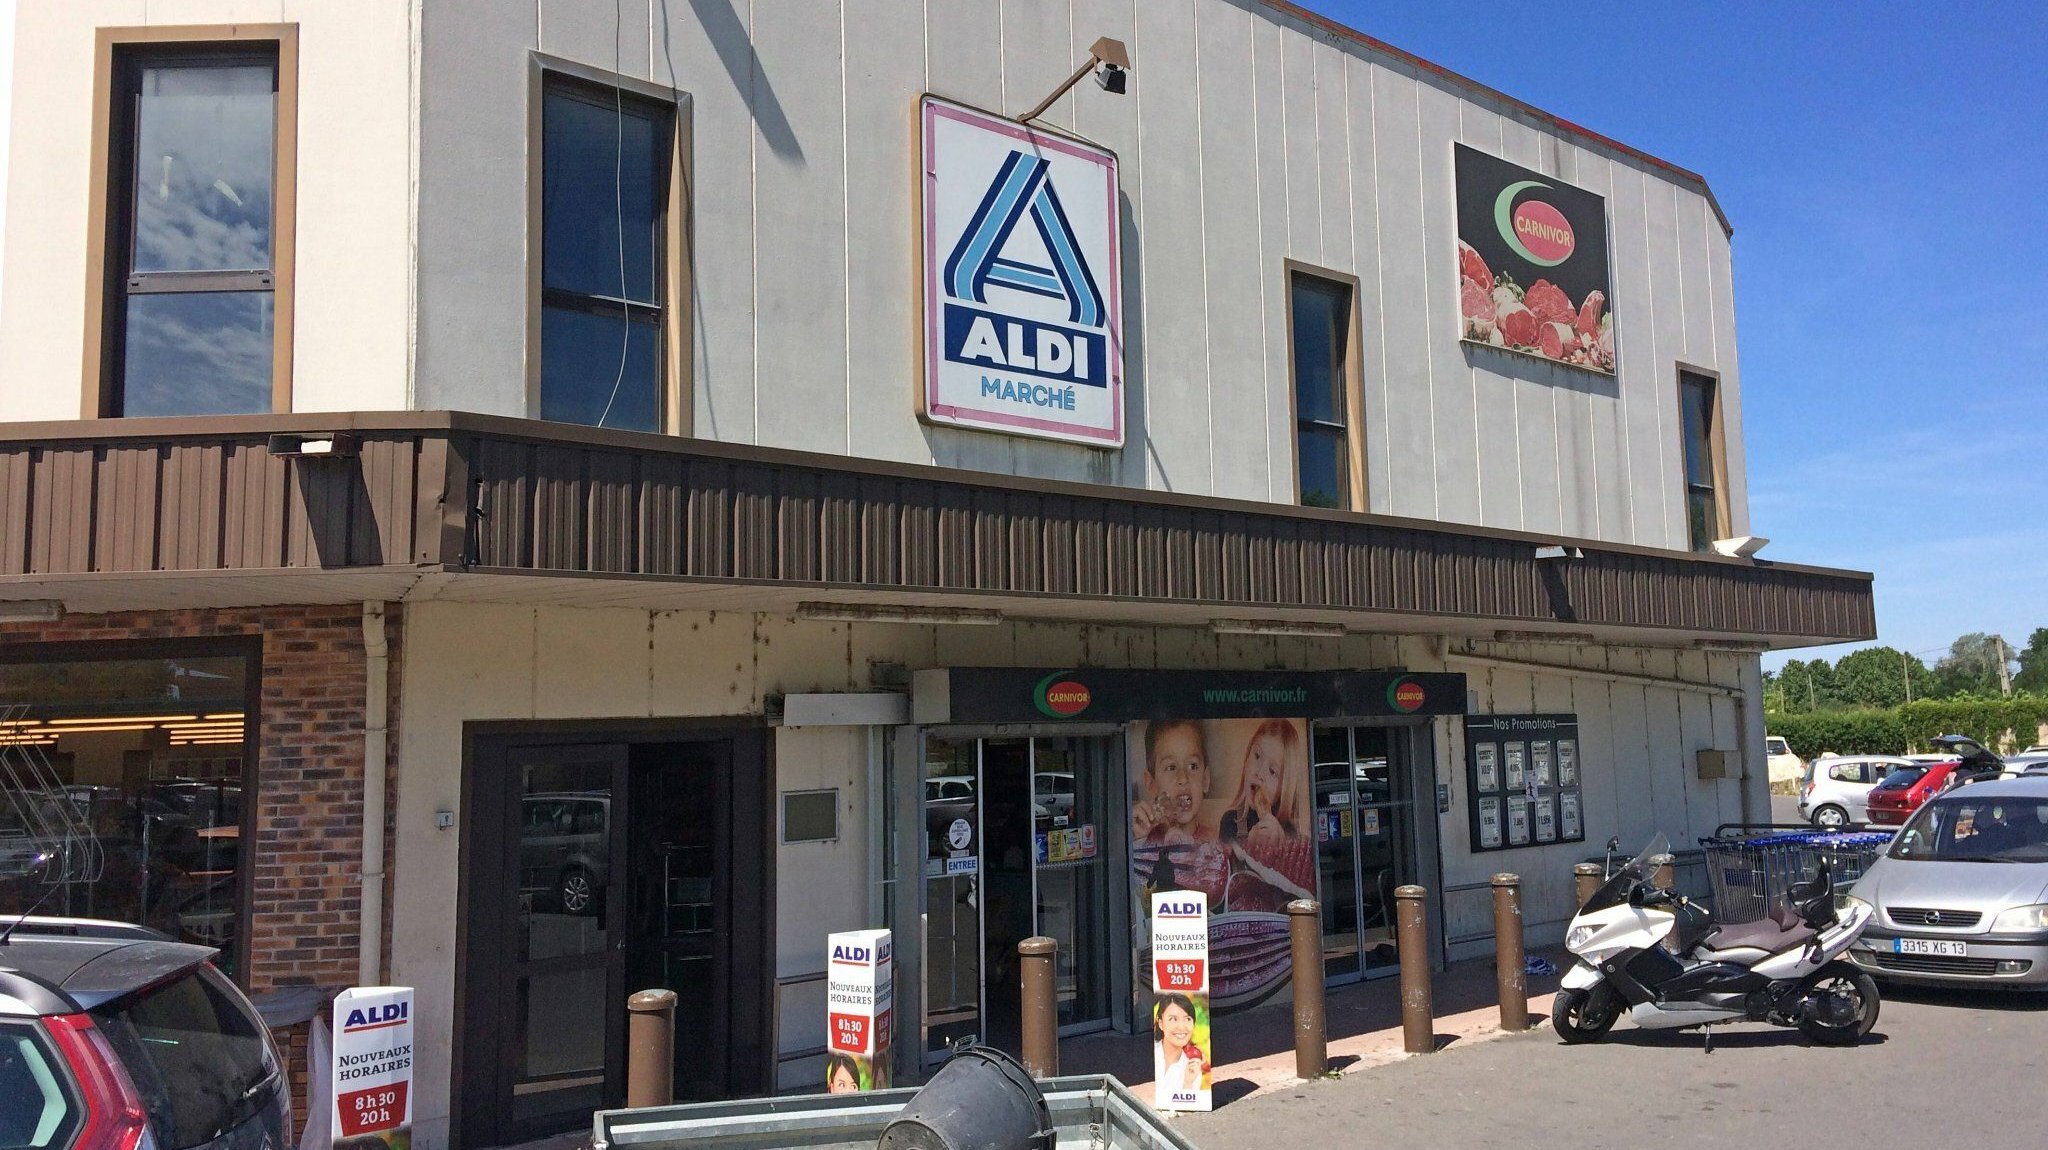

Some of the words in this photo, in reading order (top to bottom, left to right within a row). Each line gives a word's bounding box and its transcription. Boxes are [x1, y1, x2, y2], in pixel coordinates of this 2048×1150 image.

[1516, 216, 1570, 247] CARNIVOR
[960, 318, 1089, 380] ALDI
[981, 376, 1076, 411] MARCHÉ
[1049, 692, 1088, 703] CARNIVOR
[1203, 686, 1307, 703] www.carnivor.fr
[1493, 718, 1509, 730] Nos
[1512, 718, 1557, 730] Promotions
[948, 859, 976, 871] ENTREE
[1157, 902, 1202, 915] ALDI
[832, 945, 870, 962] ALDI
[1156, 942, 1206, 951] HORAIRES
[1902, 940, 1928, 953] 3315
[1933, 941, 1947, 954] XG
[1952, 942, 1965, 955] 13
[830, 993, 872, 1006] HORAIRES
[344, 1001, 408, 1027] ALDI
[339, 1057, 411, 1081] HORAIRES
[1171, 1093, 1196, 1101] ALDI
